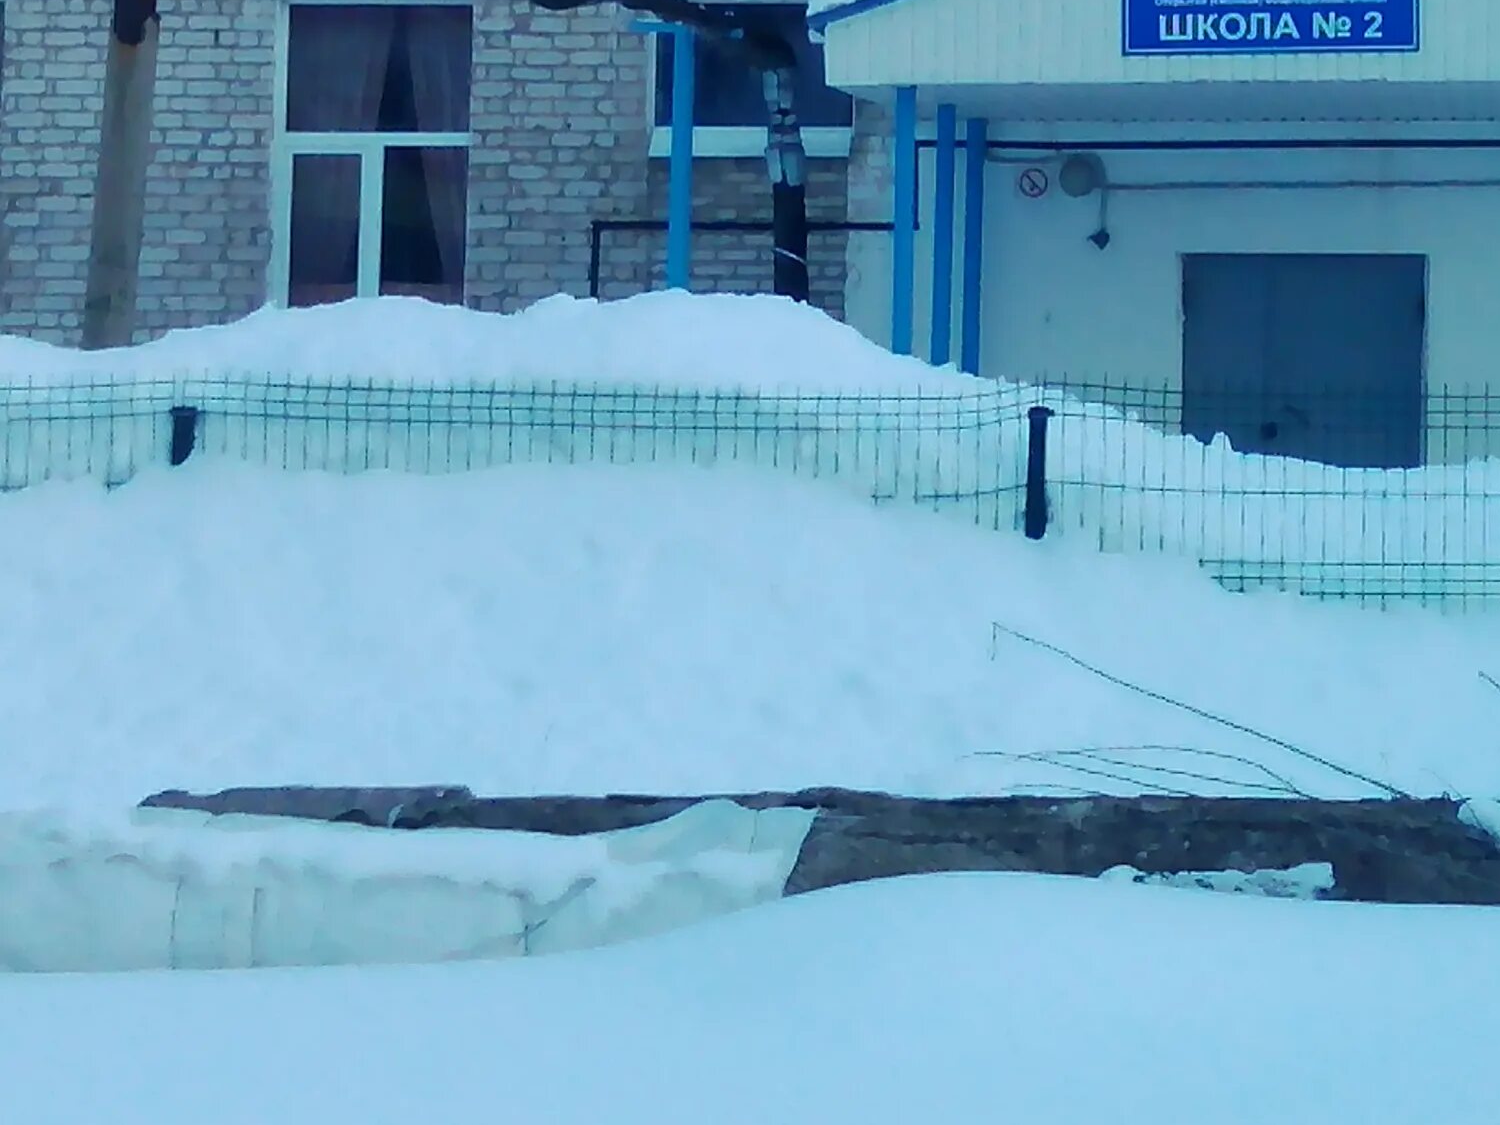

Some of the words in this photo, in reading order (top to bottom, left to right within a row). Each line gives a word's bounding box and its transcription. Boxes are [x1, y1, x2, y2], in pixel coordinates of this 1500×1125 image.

[1159, 12, 1300, 41] ШКОЛА
[1312, 11, 1352, 40] №
[1364, 10, 1383, 39] 2
